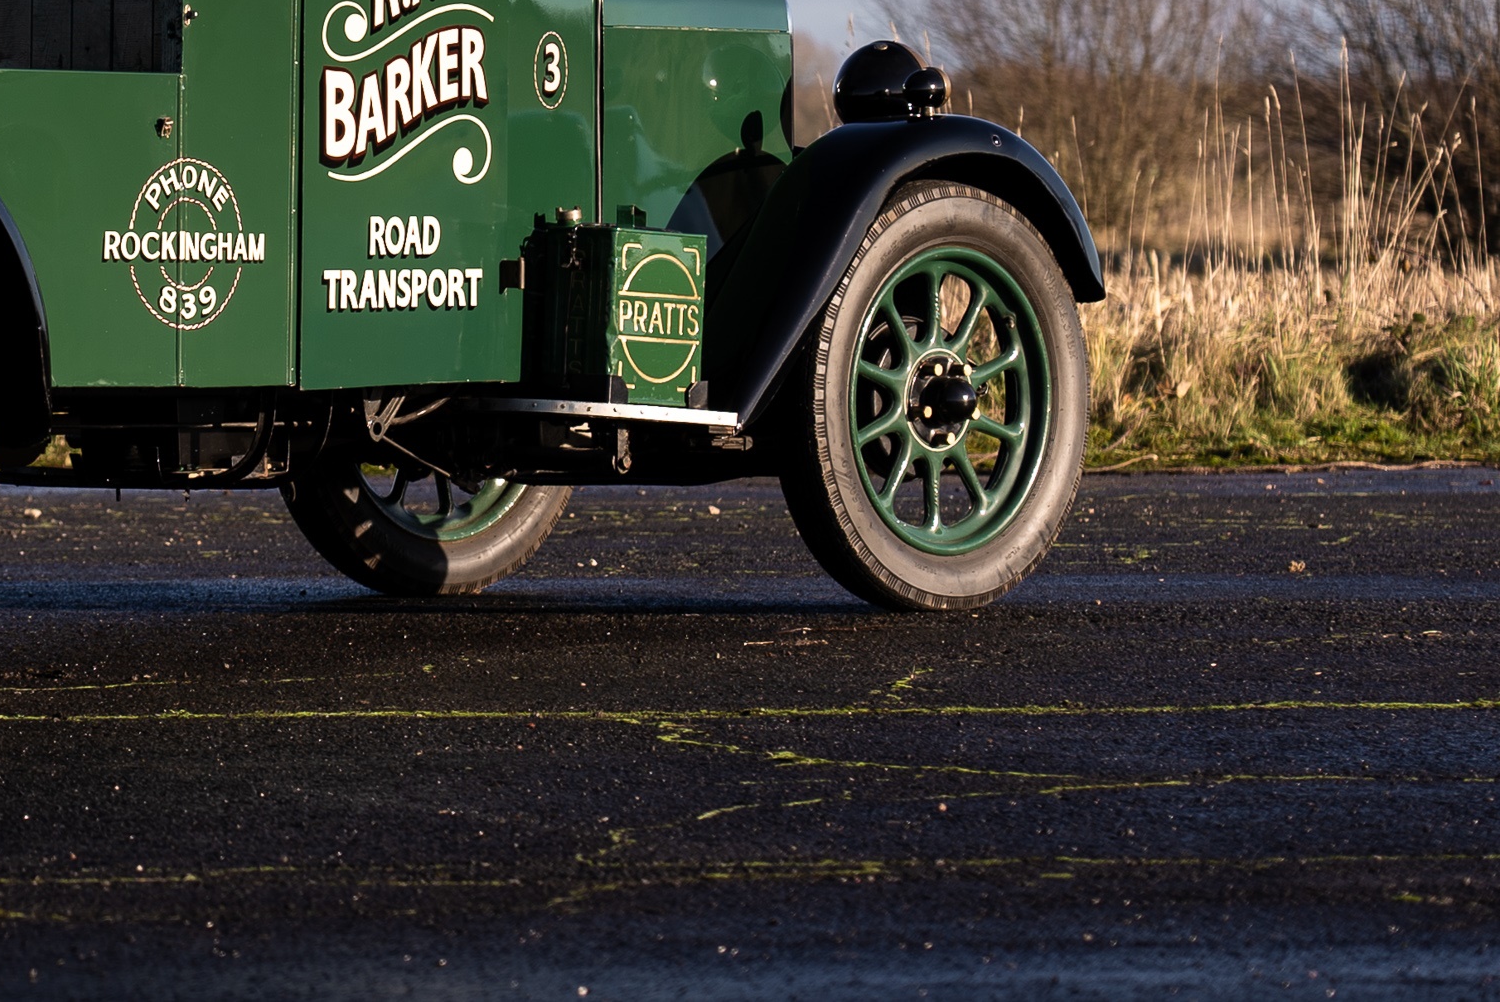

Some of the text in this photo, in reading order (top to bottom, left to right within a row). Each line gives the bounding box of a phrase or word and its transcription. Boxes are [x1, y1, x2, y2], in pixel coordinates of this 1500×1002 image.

[544, 41, 562, 96] 3
[321, 25, 489, 163] BARKER
[143, 164, 231, 213] PHONE
[102, 230, 266, 262] ROCKINGHAM
[368, 214, 442, 258] ROAD
[158, 285, 218, 321] 839
[322, 267, 484, 311] TRANSPORT
[617, 299, 700, 336] PRATTS
